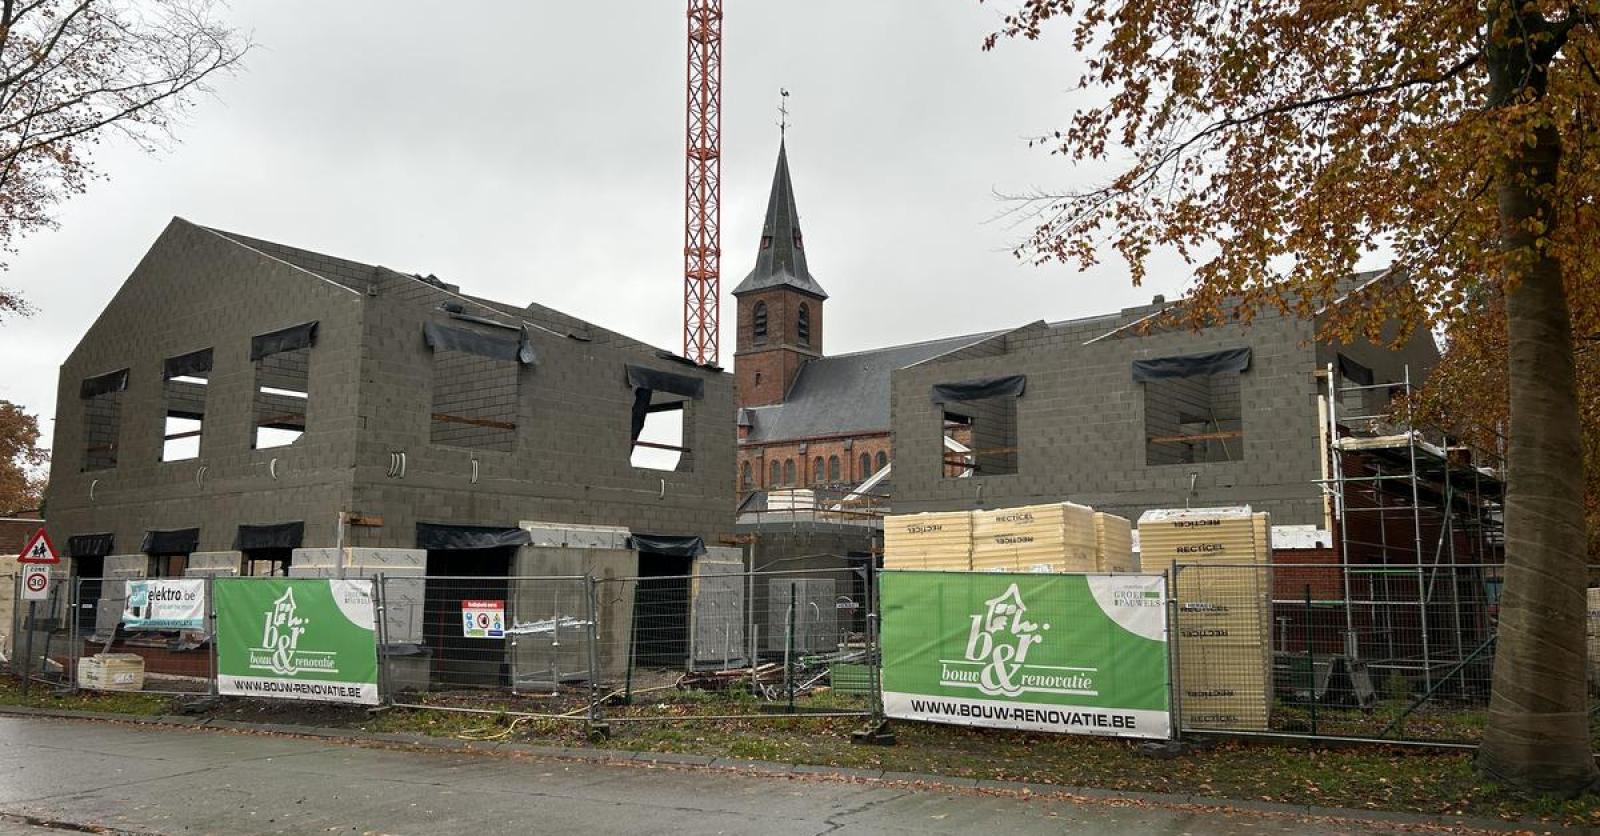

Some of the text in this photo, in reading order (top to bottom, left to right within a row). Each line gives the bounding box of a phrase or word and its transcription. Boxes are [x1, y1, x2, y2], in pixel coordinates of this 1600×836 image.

[1176, 543, 1225, 553] RECTICEL
[31, 578, 43, 586] 30
[942, 664, 980, 682] bouw
[1022, 672, 1092, 689] renovatie
[234, 680, 361, 698] WWW.BOUW-RENOVATIE.BE
[911, 699, 1136, 729] WWW.BOUW-RENOVATIE.BE
